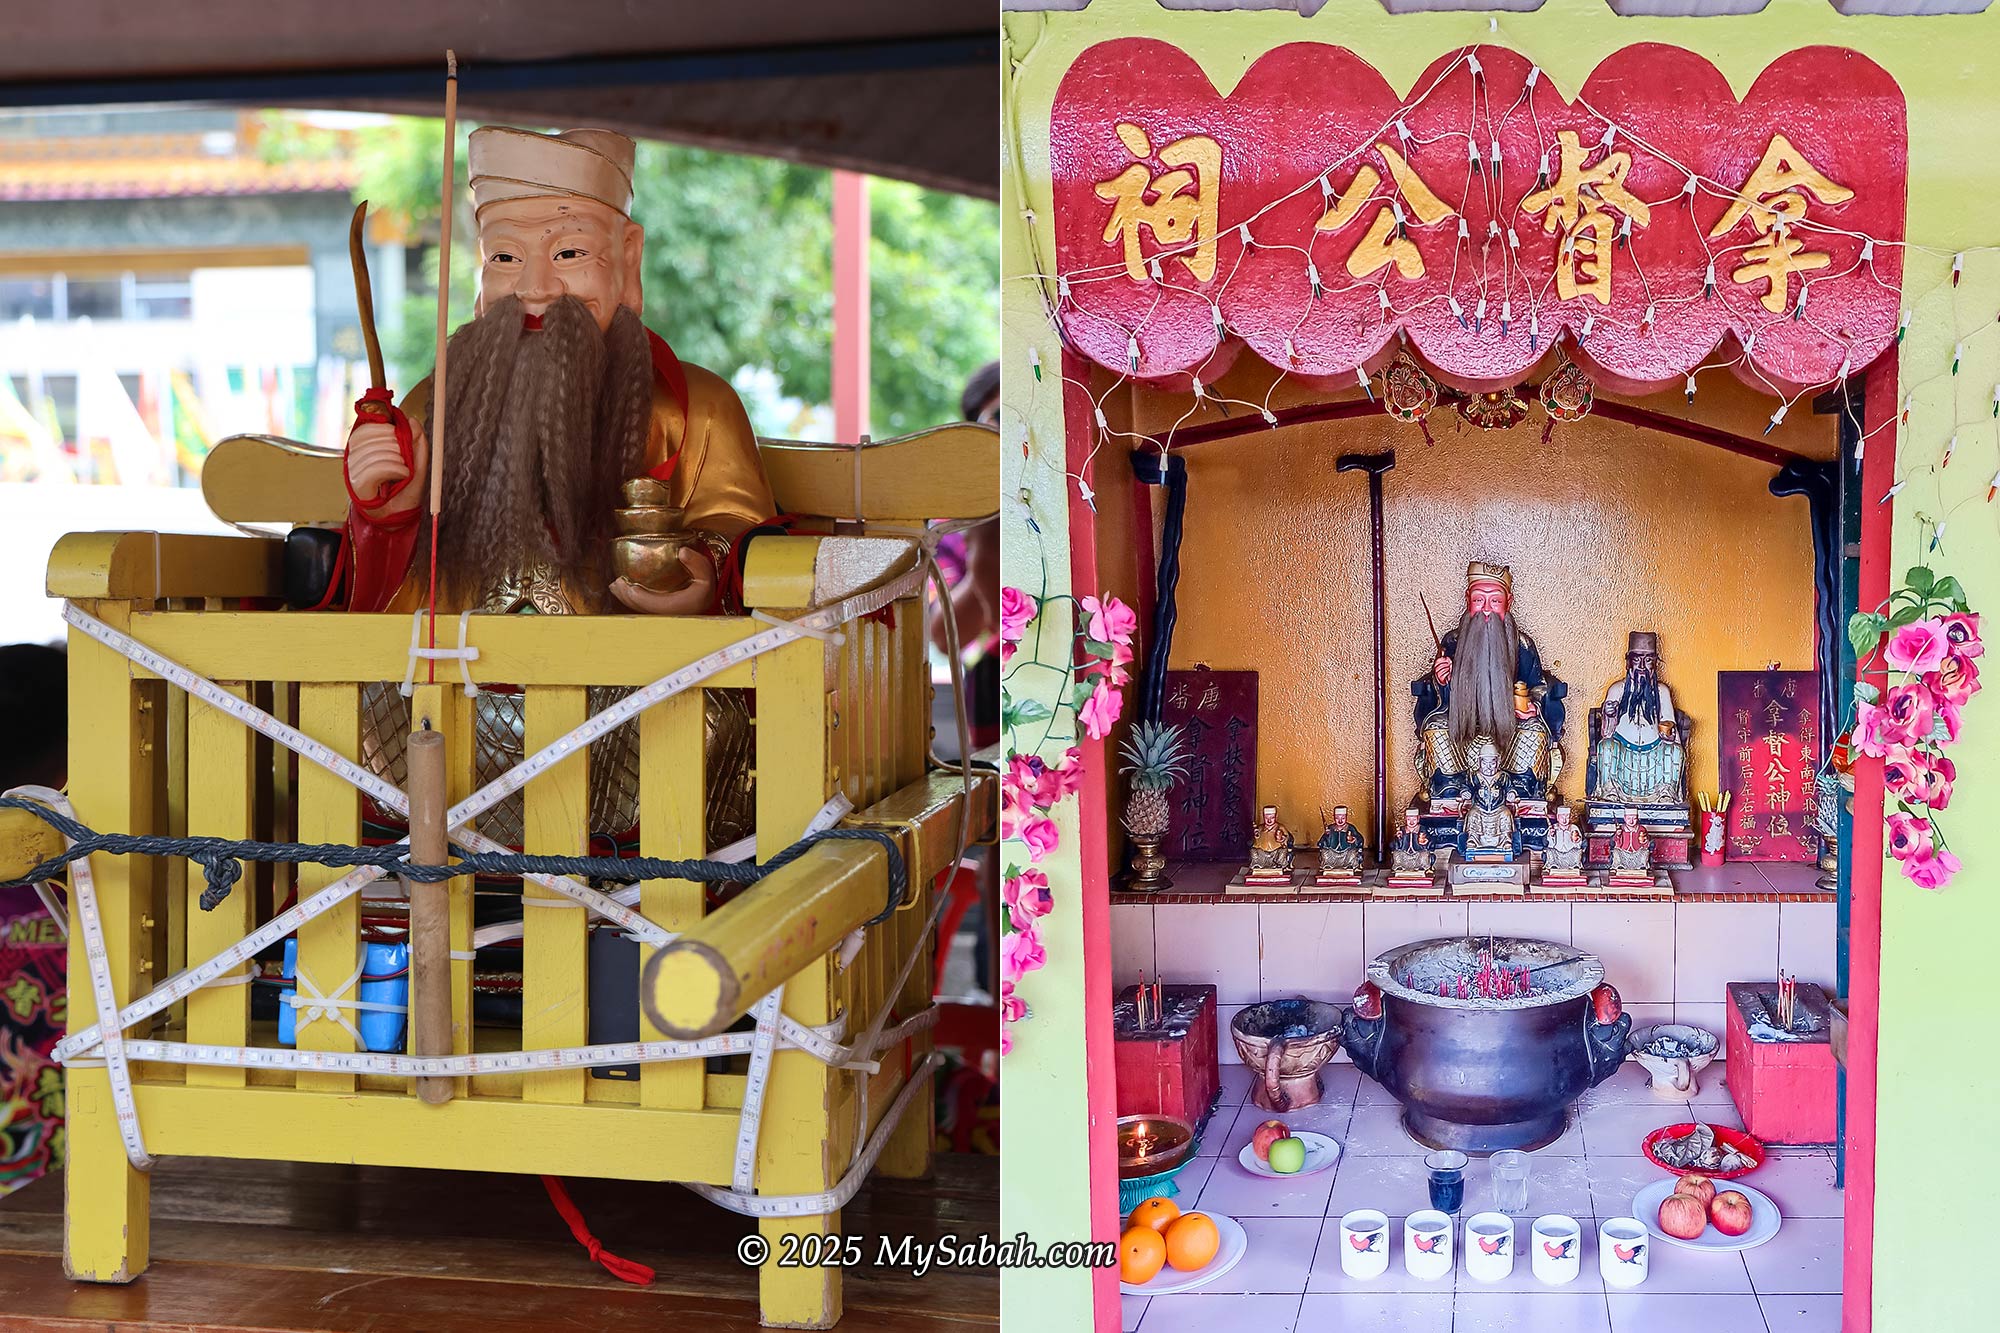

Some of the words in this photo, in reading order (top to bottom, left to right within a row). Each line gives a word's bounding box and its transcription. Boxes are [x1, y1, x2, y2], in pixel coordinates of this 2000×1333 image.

[1762, 699, 1793, 839] 拿督公神位
